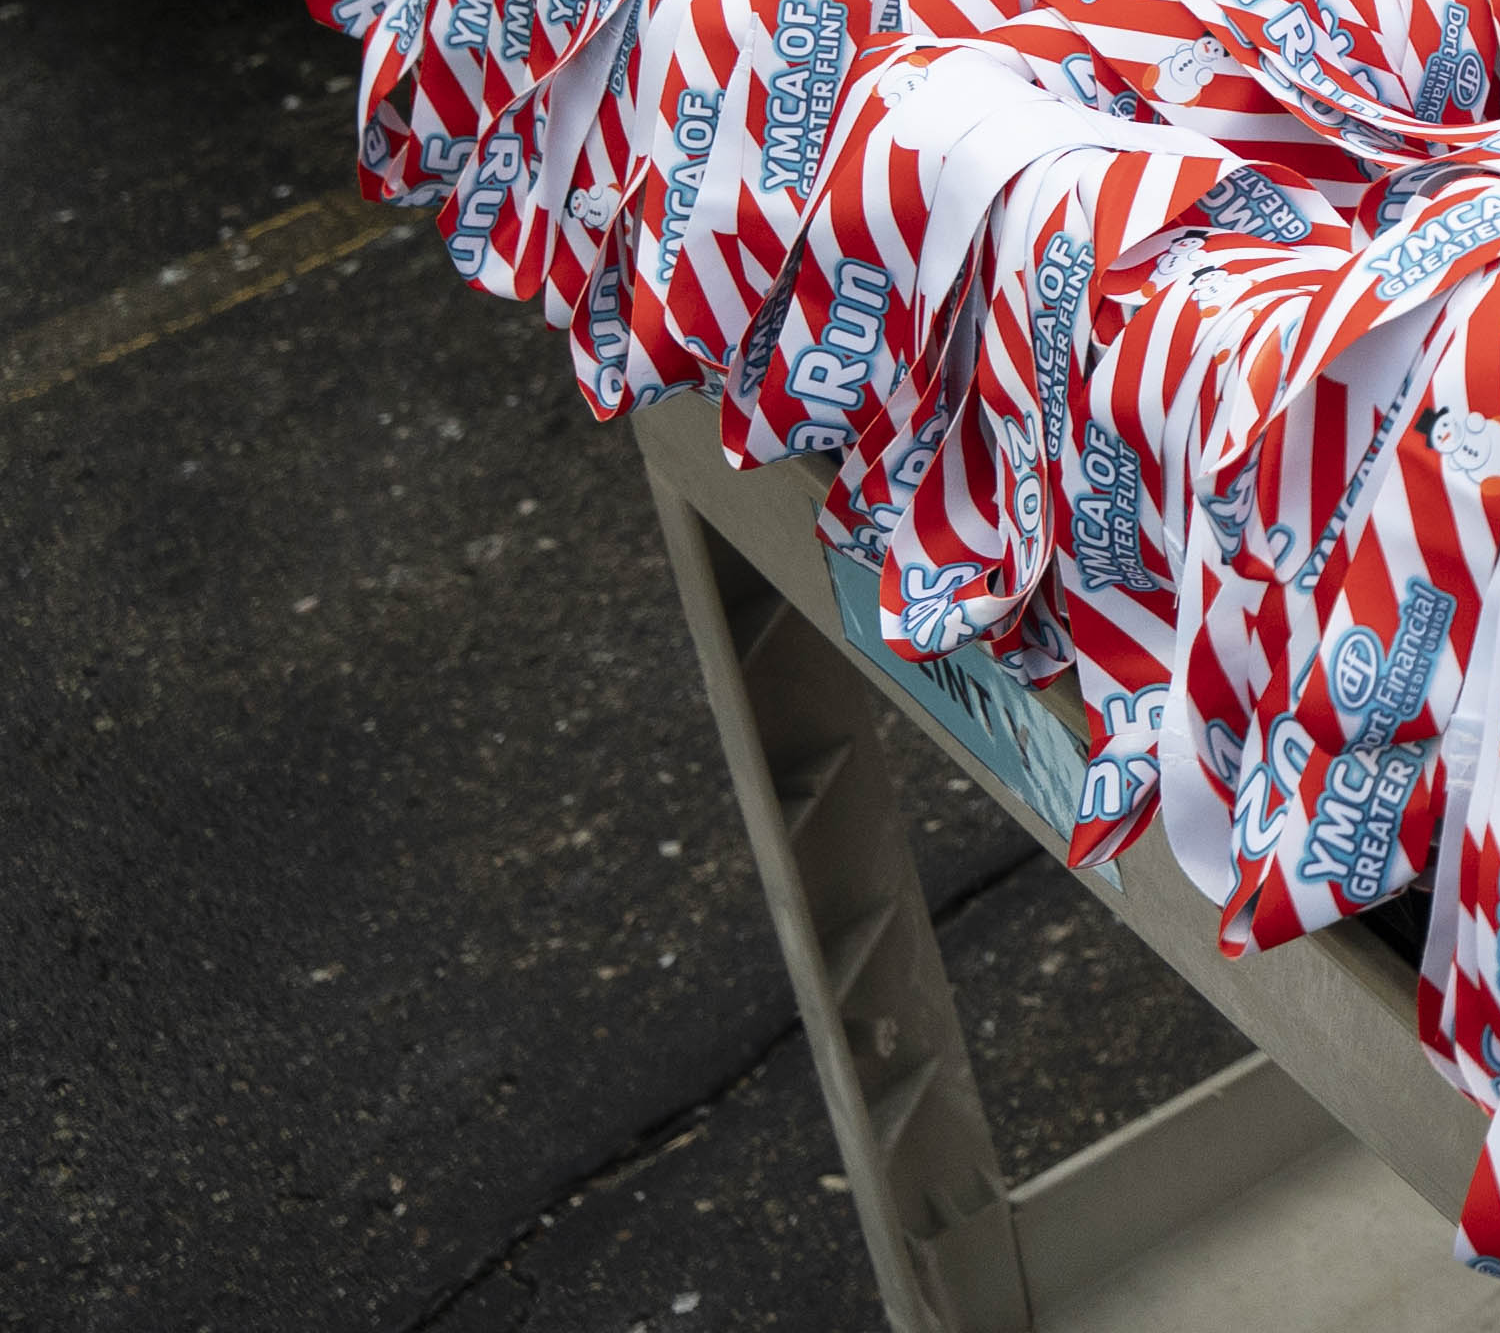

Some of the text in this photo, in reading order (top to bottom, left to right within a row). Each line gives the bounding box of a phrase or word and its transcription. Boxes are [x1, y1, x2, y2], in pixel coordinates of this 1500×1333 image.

[813, 3, 845, 78] FLINT
[1443, 7, 1465, 57] Dort
[1452, 53, 1480, 106] df
[678, 95, 714, 154] OF
[764, 3, 816, 190] YMCA OF
[451, 137, 522, 278] Run
[1040, 237, 1075, 307] OF
[788, 261, 891, 408] Run
[1048, 243, 1094, 456] GREATER FLINT
[1077, 426, 1123, 591] YMCA OF
[1107, 443, 1153, 591] GREATER FLINT
[1337, 631, 1378, 711] df
[1380, 584, 1438, 710] Financial
[1403, 598, 1451, 718] CREDIT UNION
[1349, 774, 1399, 898] GREATER
